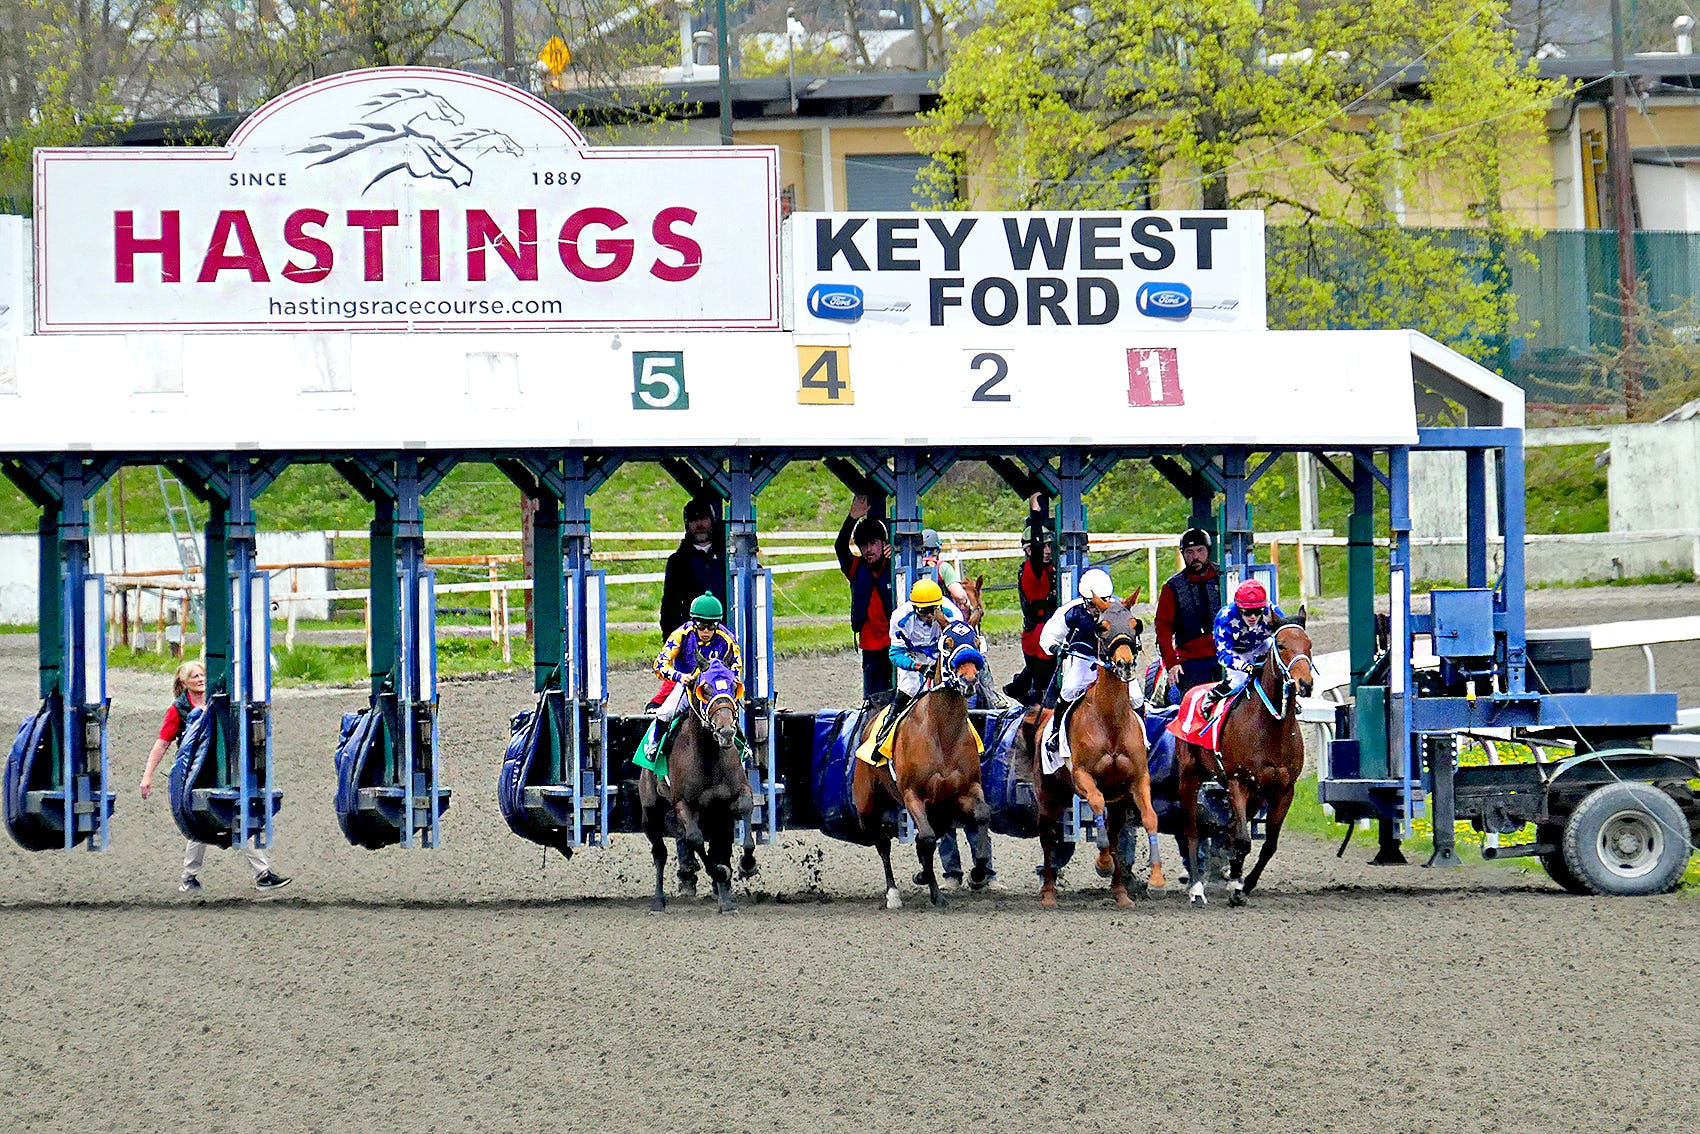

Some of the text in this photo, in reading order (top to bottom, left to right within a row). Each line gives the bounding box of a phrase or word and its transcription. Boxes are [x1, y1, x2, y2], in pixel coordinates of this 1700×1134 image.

[230, 171, 582, 187] SINCE 1889
[115, 206, 702, 284] HASTINGS
[816, 216, 1228, 272] KEY WEST
[269, 296, 563, 318] hastingsracecourse.com
[829, 295, 852, 306] Ford
[929, 277, 1120, 327] FORD
[1158, 293, 1180, 305] Ford
[638, 356, 682, 408] 5
[801, 351, 847, 400] 4
[971, 352, 1012, 402] 2
[1140, 352, 1164, 402] 1
